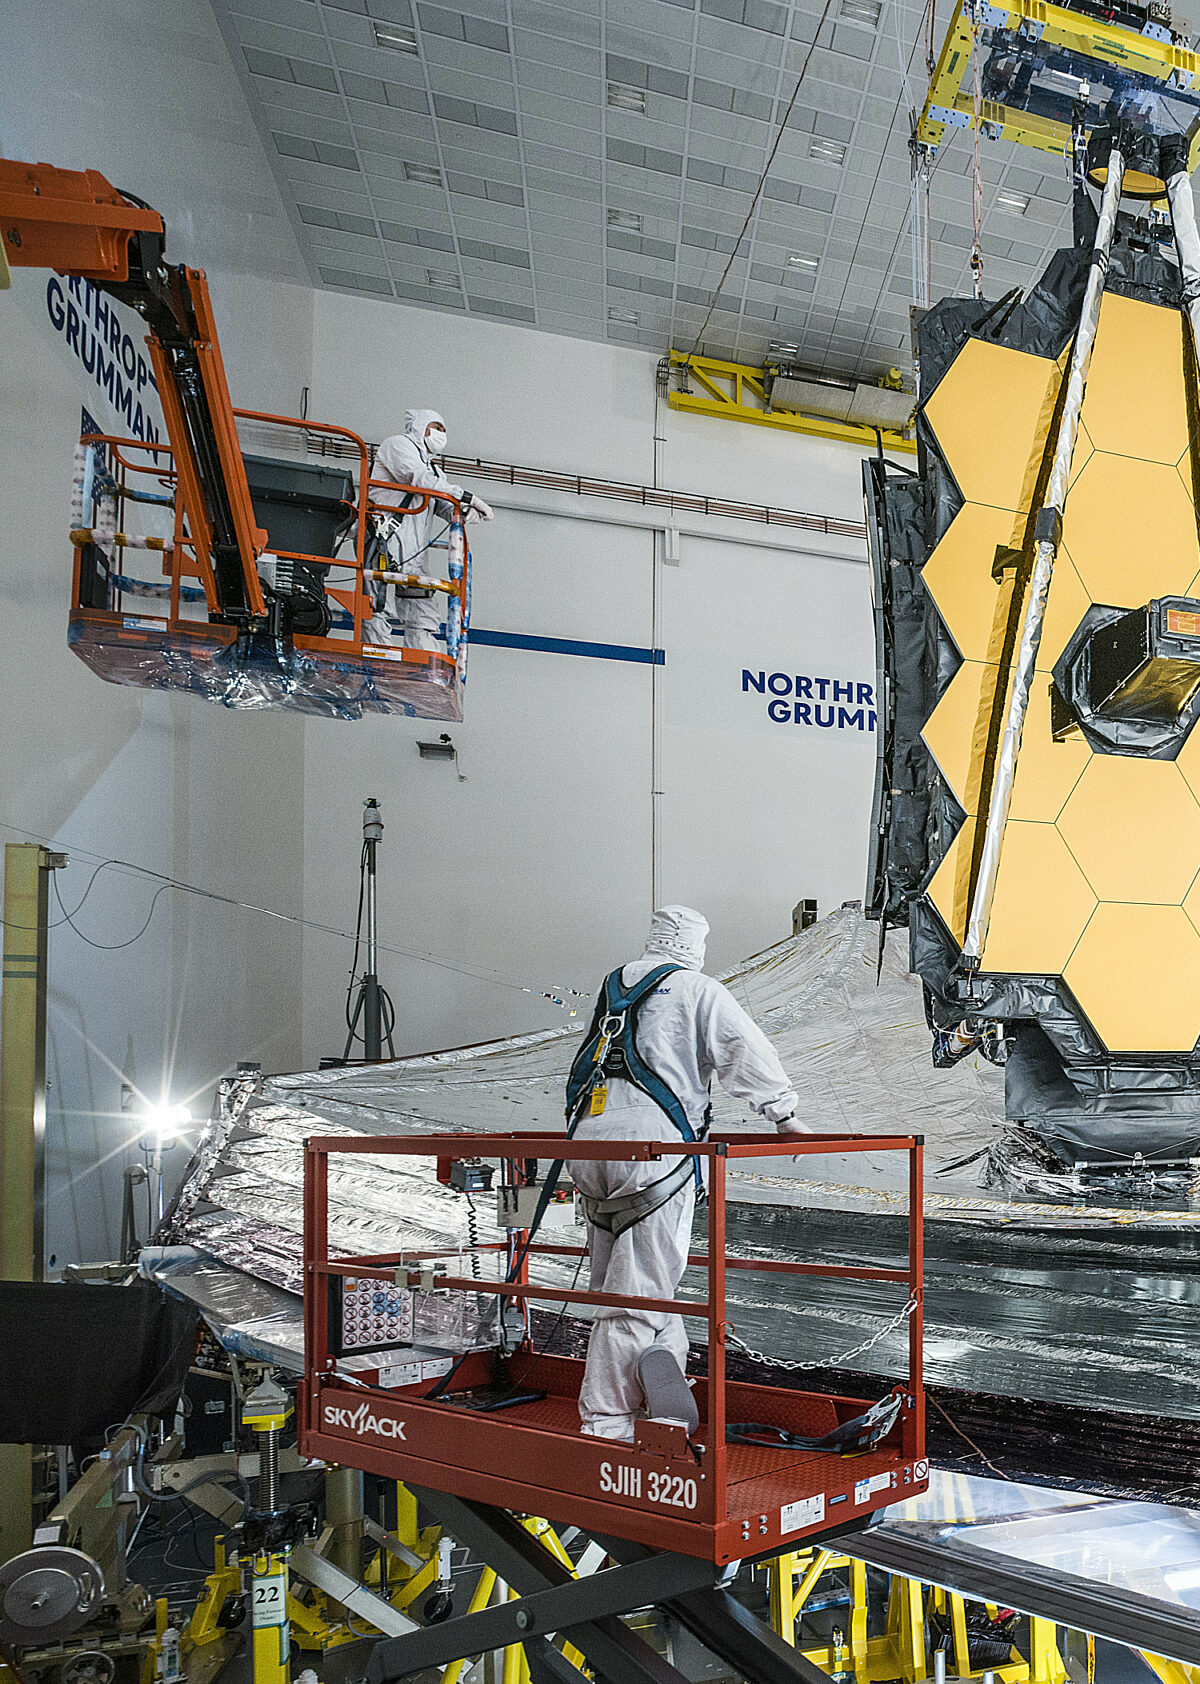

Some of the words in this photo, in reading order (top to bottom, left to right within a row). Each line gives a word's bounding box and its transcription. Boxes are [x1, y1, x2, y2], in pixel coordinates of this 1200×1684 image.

[46, 277, 159, 466] GRUMMAN
[324, 1402, 407, 1440] SKYJACK
[647, 1472, 698, 1510] 3220
[254, 1586, 280, 1604] 22
